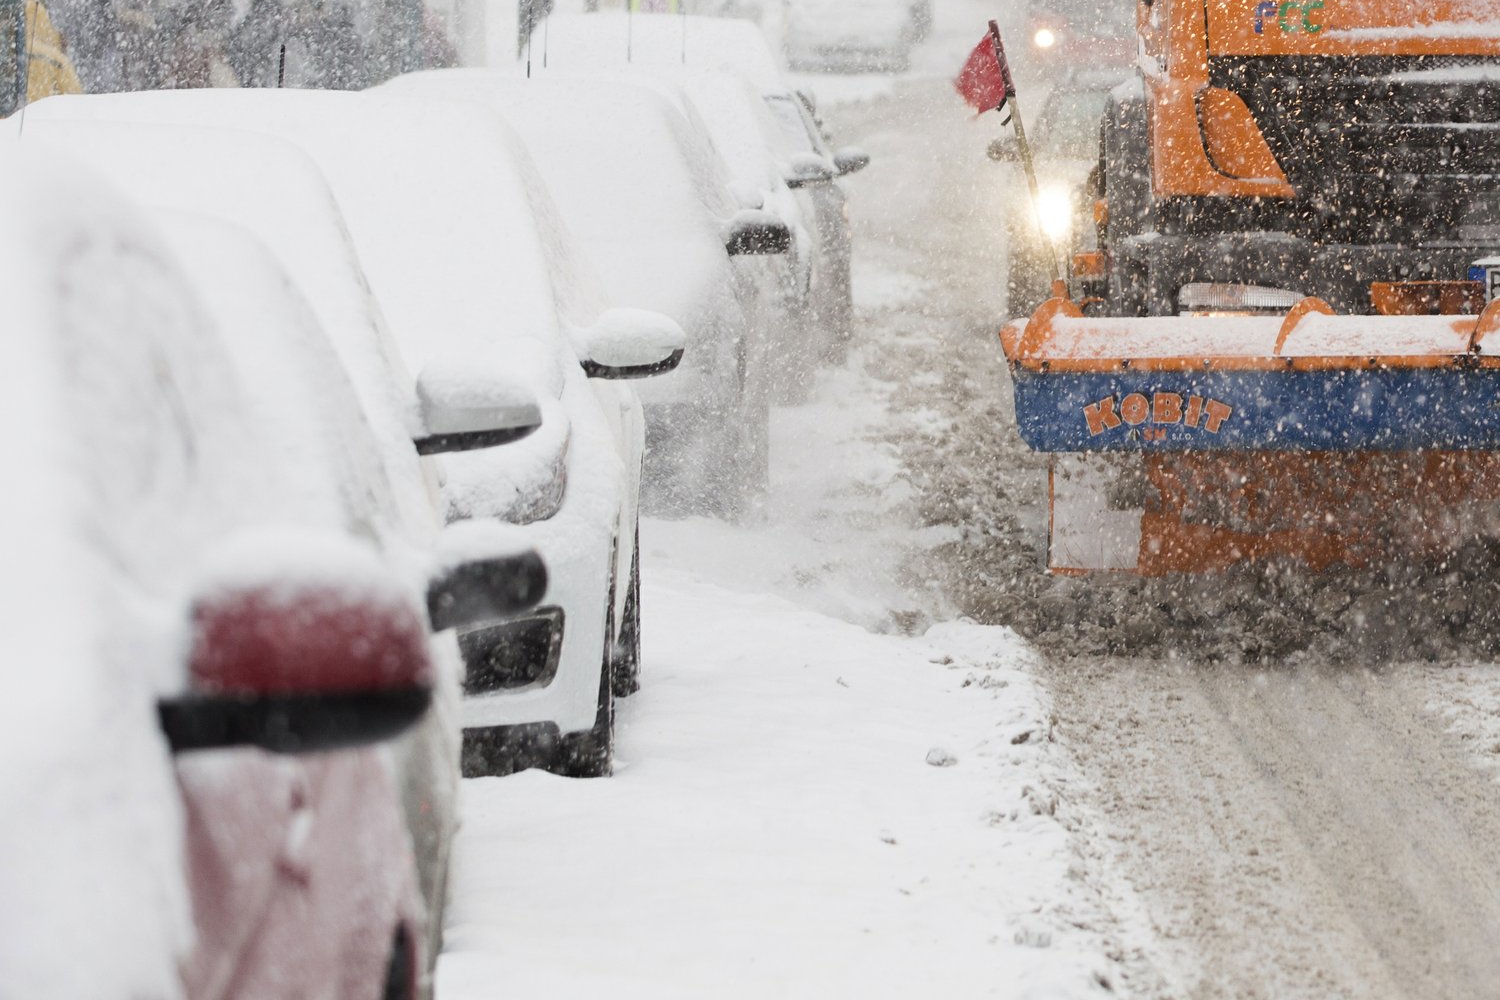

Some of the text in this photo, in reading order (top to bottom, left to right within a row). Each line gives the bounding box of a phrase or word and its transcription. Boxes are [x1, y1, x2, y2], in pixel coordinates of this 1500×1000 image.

[1254, 0, 1325, 33] FCC
[1083, 392, 1232, 437] KOBIT
[1143, 426, 1168, 441] SM
